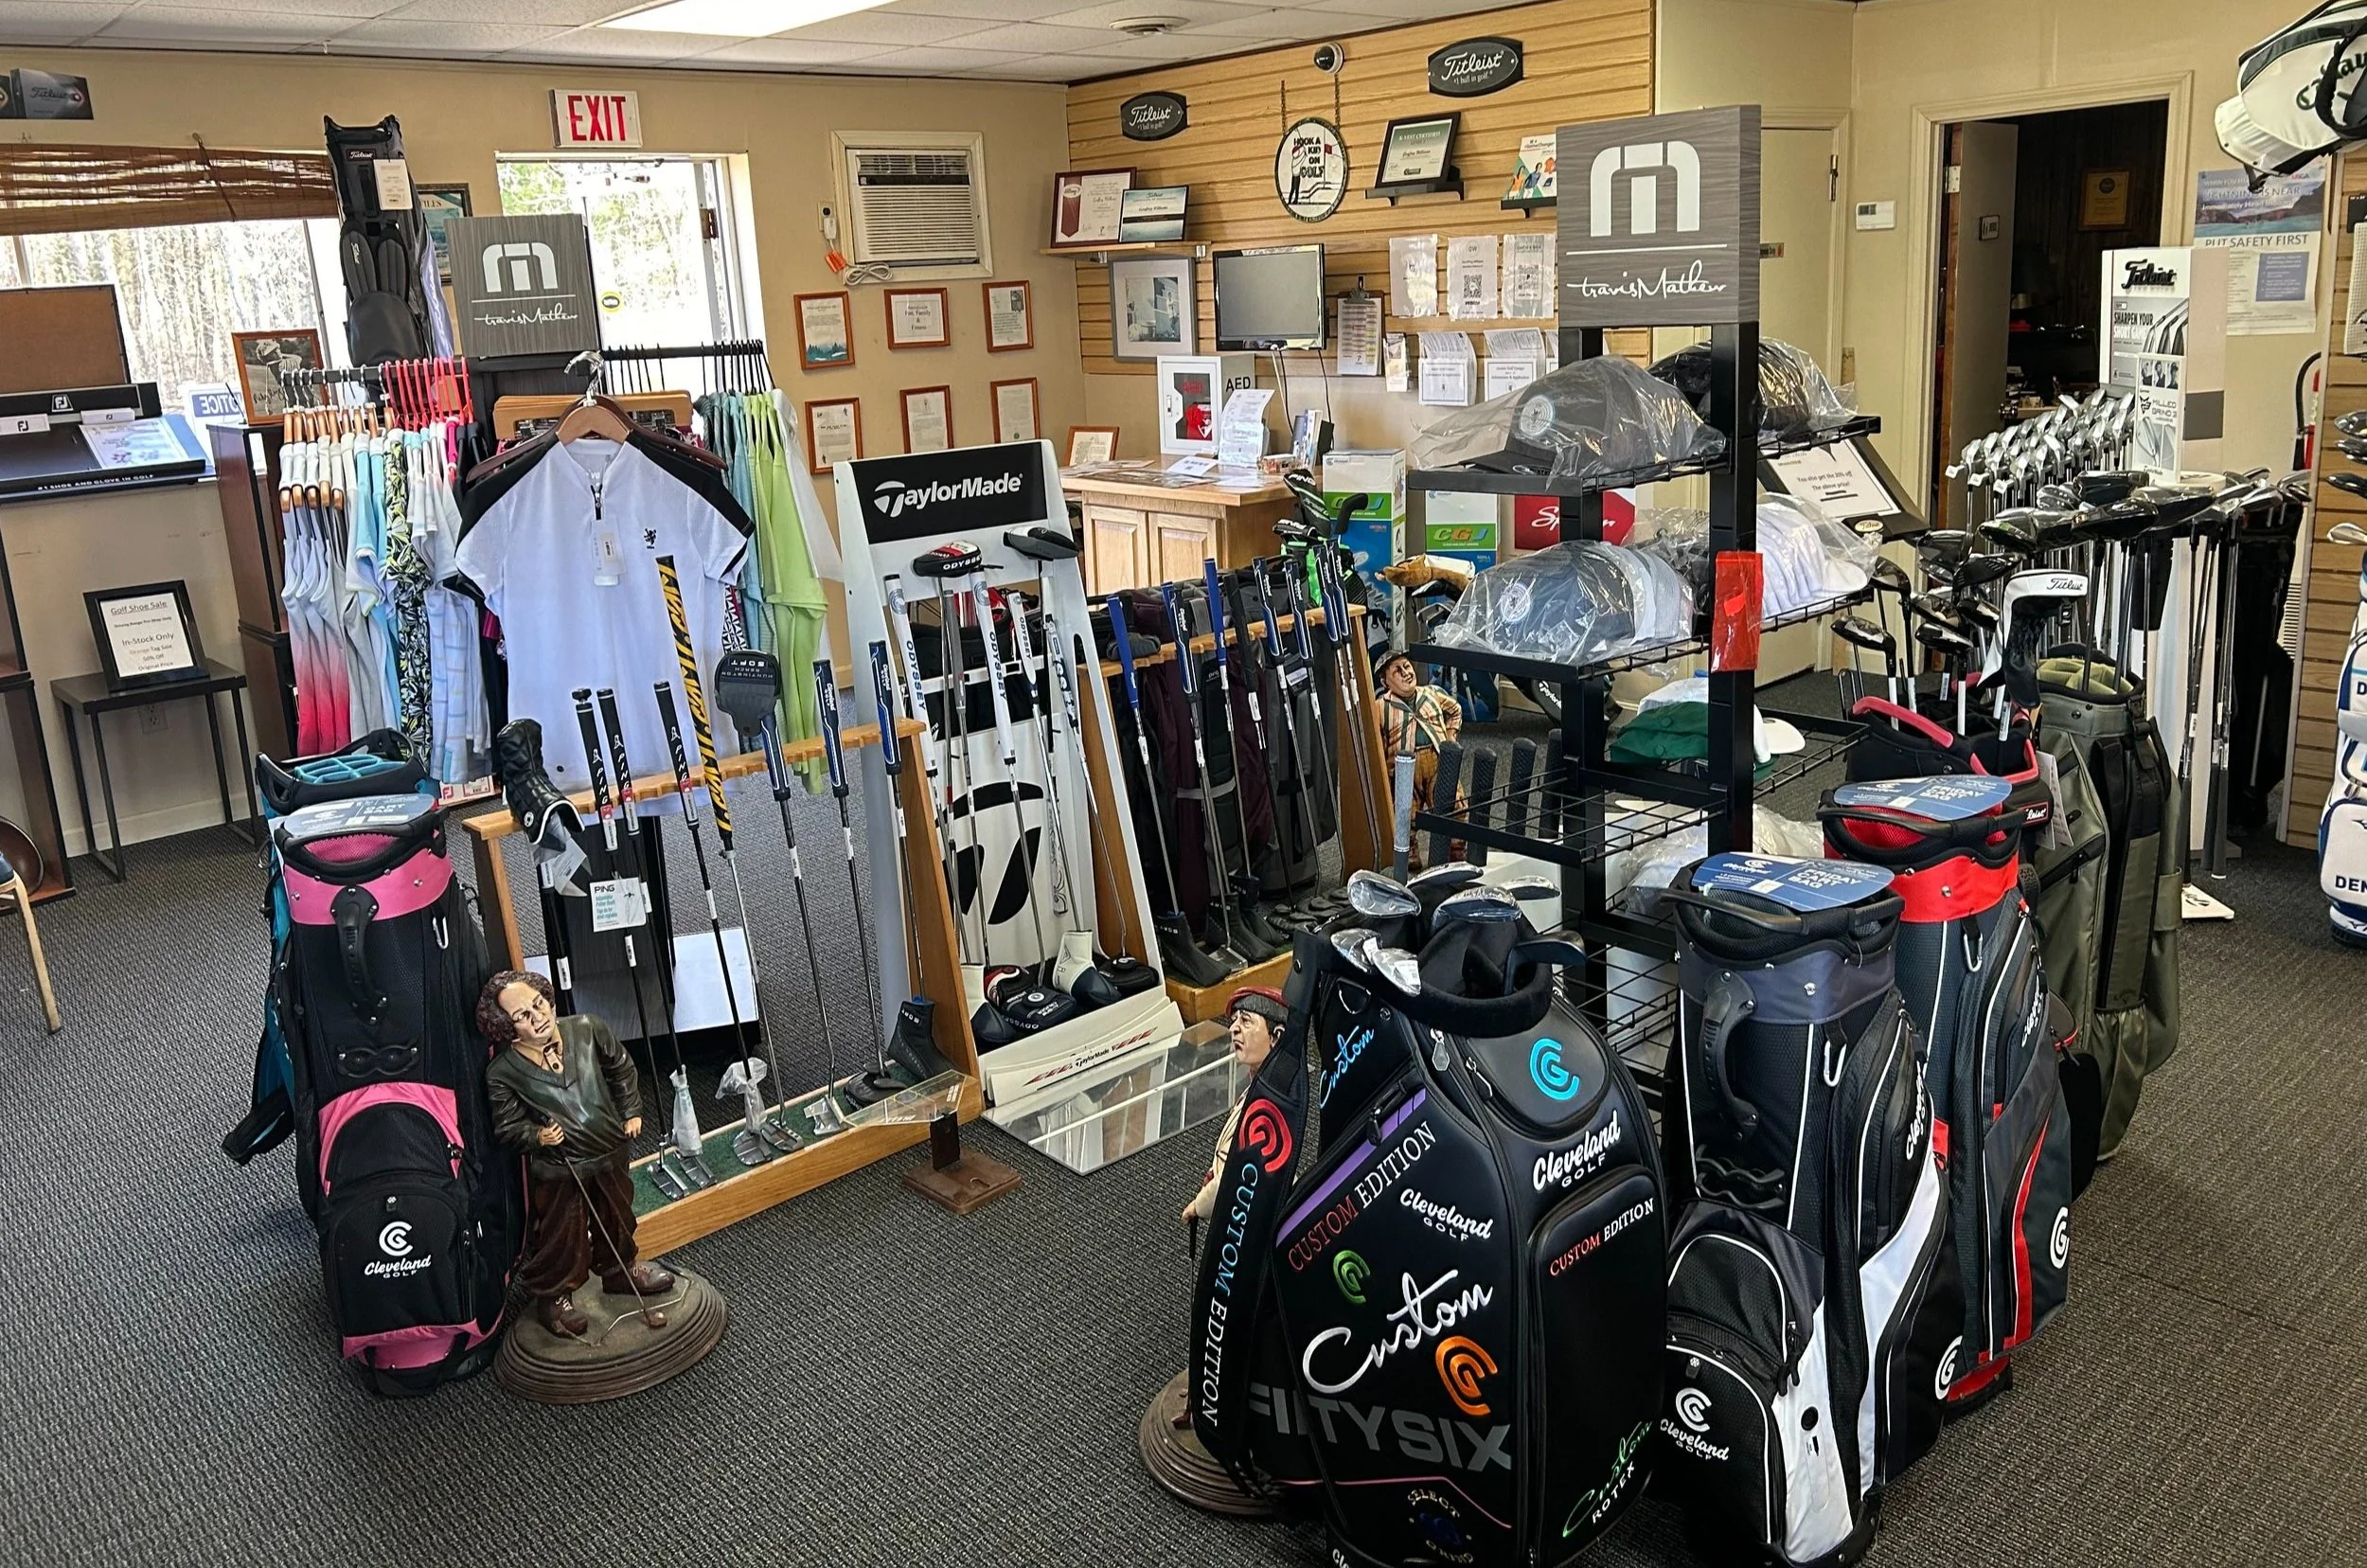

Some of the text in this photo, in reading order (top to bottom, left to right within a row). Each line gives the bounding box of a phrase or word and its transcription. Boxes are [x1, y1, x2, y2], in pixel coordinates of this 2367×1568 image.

[1441, 51, 1501, 81] Titleist
[567, 95, 627, 141] EXIT
[1130, 104, 1171, 127] Titleist
[1308, 146, 1321, 154] KID
[1300, 166, 1325, 178] GOLF
[2271, 187, 2301, 197] NEAR
[2202, 200, 2244, 211] Immediately
[2229, 236, 2271, 248] SAFETY
[2276, 234, 2308, 246] FIRST
[2114, 312, 2154, 326] SHARPEN YOUR
[1225, 376, 1251, 392] AED
[17, 420, 29, 432] FJ
[874, 472, 1022, 518] TaylorMade
[1331, 497, 1384, 510] CJ
[942, 556, 982, 571] ODYSSE
[2046, 578, 2083, 591] Titleist
[111, 600, 168, 614] Golf Shoe Sale
[122, 633, 174, 647] In-Stock Only
[1019, 616, 1032, 660] ODYSSEY
[138, 663, 160, 671] Original
[906, 640, 925, 710] ODYSSEY
[989, 631, 1007, 704] ODYSSEY
[617, 752, 630, 790] PING
[676, 744, 688, 782] PING
[596, 768, 609, 805] PING
[1919, 792, 1951, 801] BAG
[1931, 785, 1985, 796] FRIDAY
[1788, 876, 1824, 888] BAG
[1797, 873, 1842, 886] CART
[1805, 868, 1862, 884] FRIDAY
[595, 884, 614, 893] PING
[1075, 1047, 1110, 1067] TaylorMade
[1320, 1025, 1374, 1110] Custom
[1533, 1110, 1621, 1191] Cleveland
[1562, 1153, 1606, 1187] GOLF
[1289, 1121, 1436, 1273] CUSTOM EDITION
[1399, 1188, 1493, 1239] Cleveland
[1423, 1217, 1468, 1242] GOLF
[1550, 1197, 1654, 1276] CUSTOM EDITION
[364, 1255, 432, 1275] Cleveland
[383, 1270, 417, 1279] GOLF
[1201, 1163, 1258, 1427] CUSTOM EDITION
[1303, 1269, 1494, 1394] Custom
[1660, 1418, 1729, 1461] Cleveland
[1676, 1440, 1712, 1460] GOLF
[1592, 1461, 1634, 1523] ROTEX
[1407, 1488, 1460, 1518] SELECT
